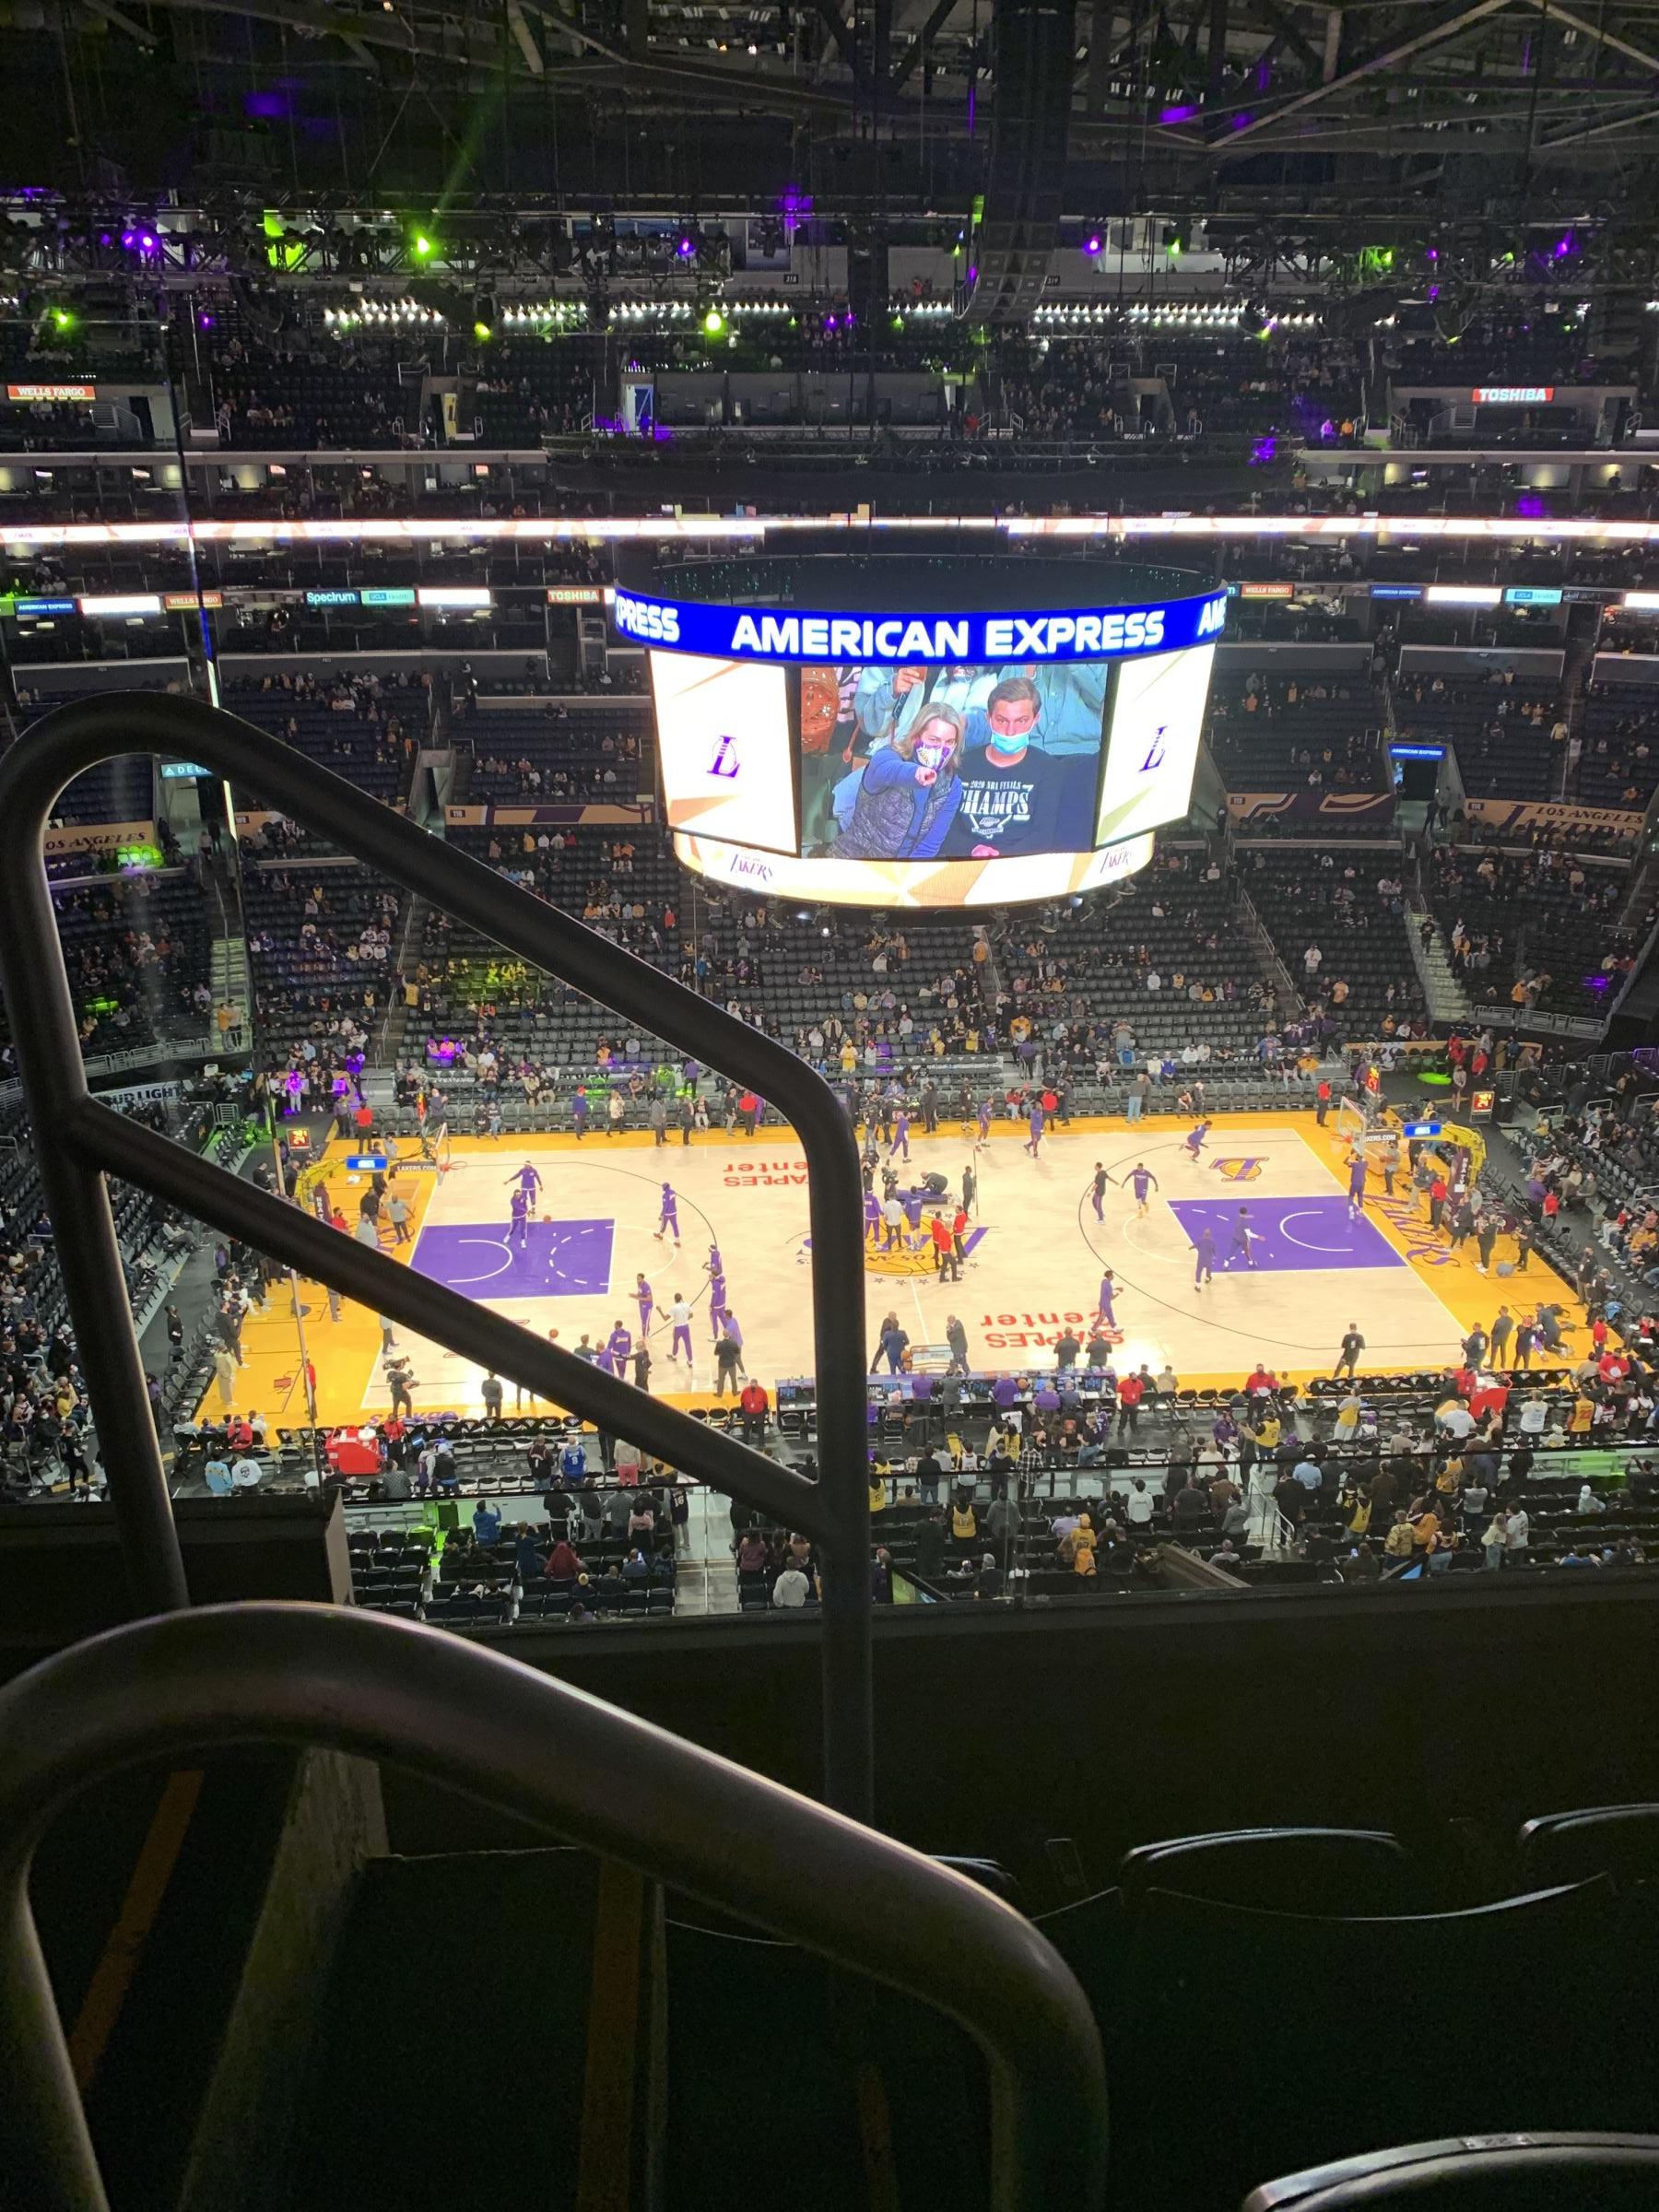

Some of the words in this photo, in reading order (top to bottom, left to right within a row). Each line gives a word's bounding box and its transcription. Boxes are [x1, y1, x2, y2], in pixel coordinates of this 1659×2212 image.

[18, 387, 52, 396] WELLS
[53, 387, 86, 396] FARGO
[1479, 388, 1547, 401] TOSHIBA
[170, 596, 195, 606] WELLS
[306, 592, 356, 605] Spectrum
[548, 591, 599, 600] TOSHIBA
[731, 614, 969, 657] AMERICAN
[985, 611, 1166, 657] EXPRESS
[178, 765, 212, 775] DEL
[971, 781, 985, 789] 2020
[986, 781, 998, 790] NBA
[1535, 806, 1566, 818] LOS
[1568, 809, 1644, 825] ANGELES
[45, 839, 65, 851] OS
[69, 831, 147, 848] ANGELES
[724, 1161, 808, 1173] enter
[724, 1174, 809, 1188] APLES
[571, 1456, 579, 1465] 8
[674, 1495, 685, 1508] 16
